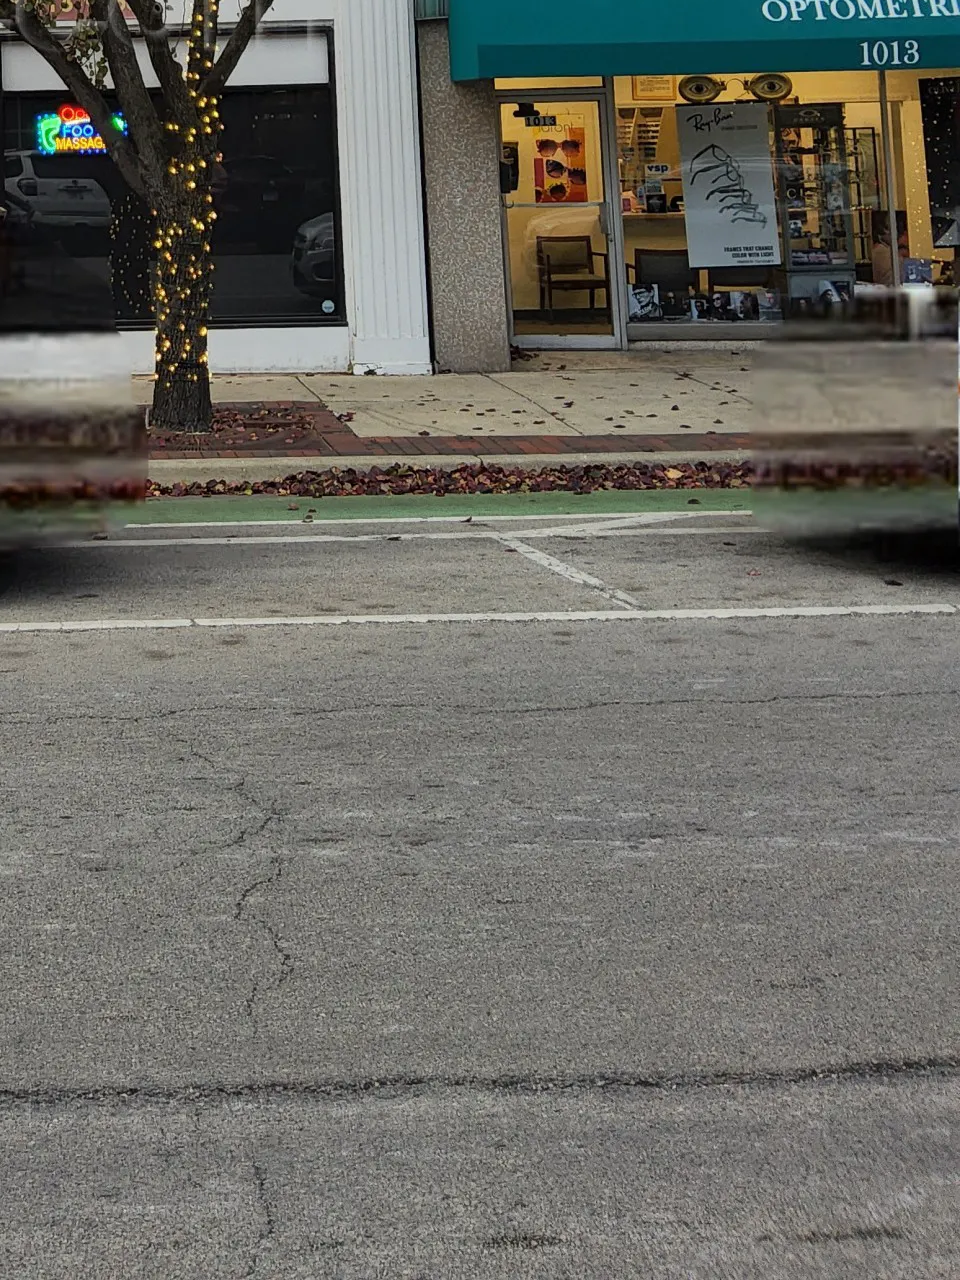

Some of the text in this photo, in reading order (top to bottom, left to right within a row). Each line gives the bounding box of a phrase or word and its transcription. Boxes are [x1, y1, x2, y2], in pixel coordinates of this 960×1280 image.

[859, 39, 920, 66] 1013
[526, 116, 556, 126] 1013
[61, 124, 95, 138] FOO
[55, 136, 106, 150] MASSAG
[646, 164, 669, 173] vsp
